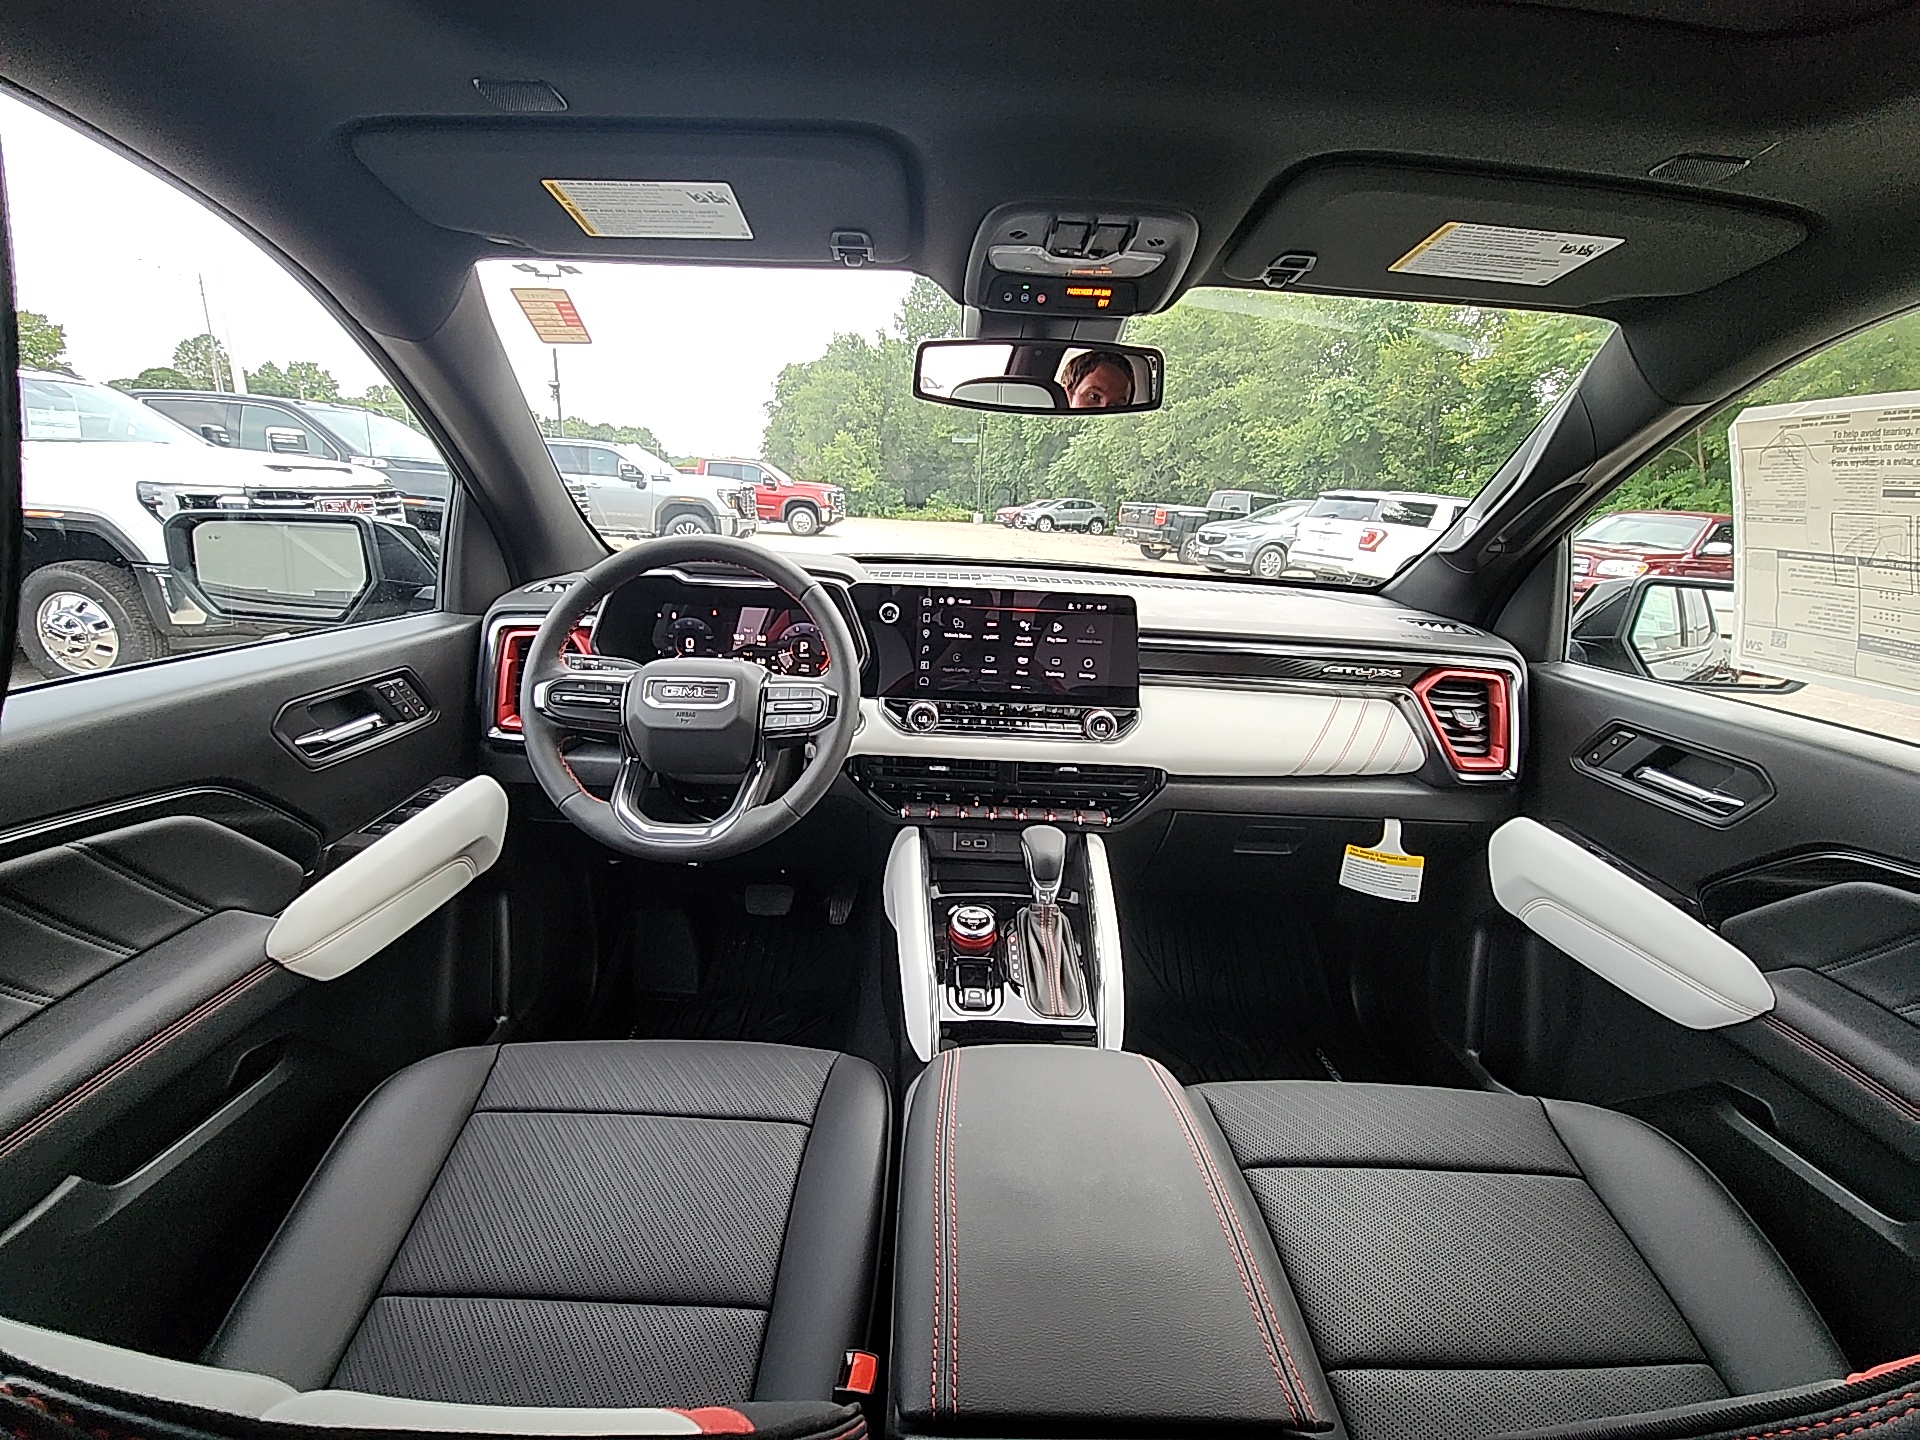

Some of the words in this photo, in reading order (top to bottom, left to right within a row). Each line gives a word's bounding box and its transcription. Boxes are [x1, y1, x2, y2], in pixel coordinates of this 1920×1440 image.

[1832, 430, 1842, 440] To
[1843, 429, 1859, 440] help
[1860, 427, 1881, 438] avoid
[1831, 444, 1848, 454] Pour
[1831, 458, 1849, 468] Para
[1886, 458, 1892, 466] a
[684, 637, 696, 649] 0
[799, 641, 809, 653] P
[662, 685, 719, 698] GMC
